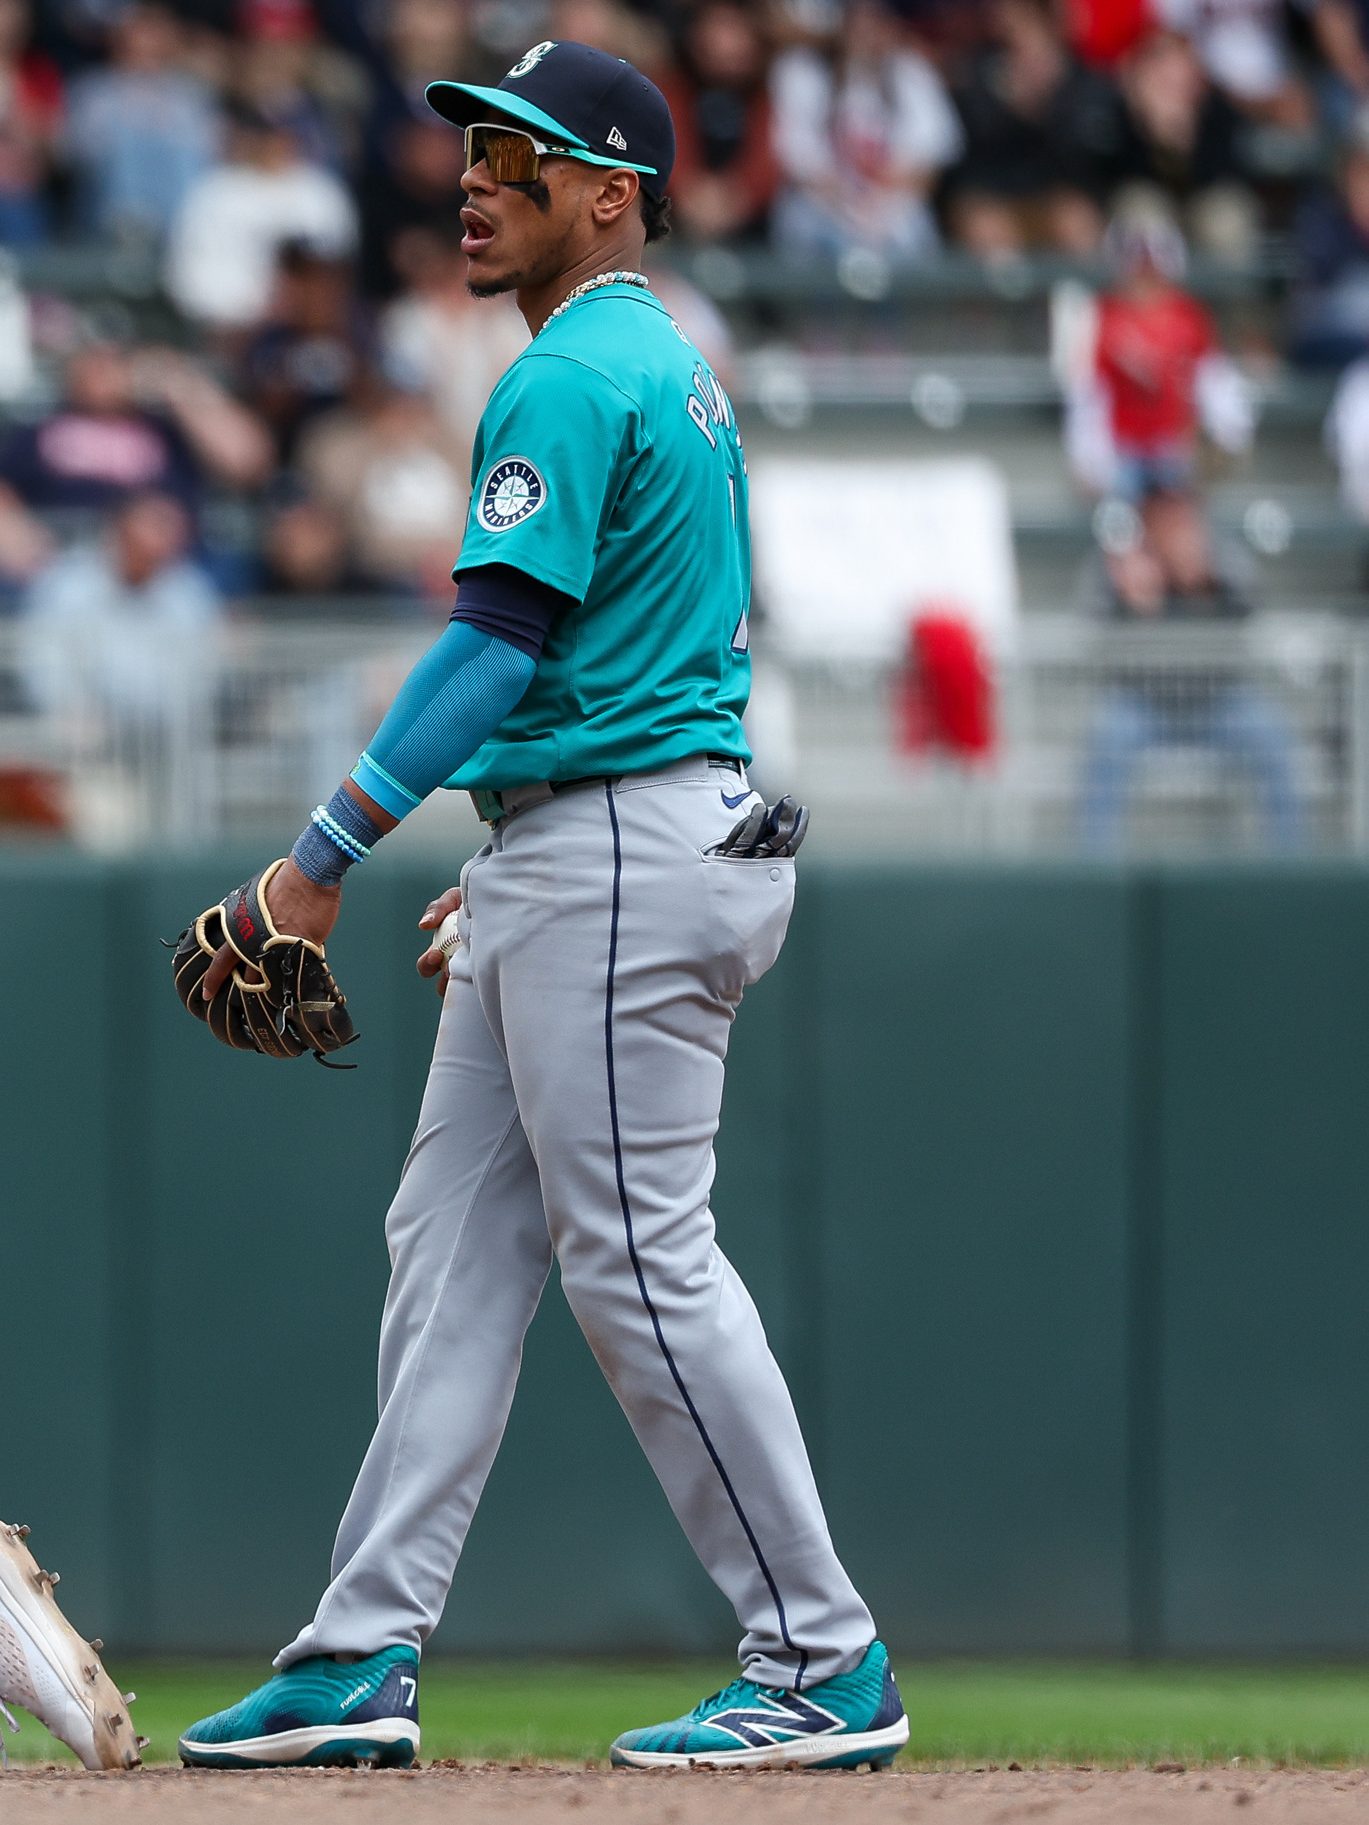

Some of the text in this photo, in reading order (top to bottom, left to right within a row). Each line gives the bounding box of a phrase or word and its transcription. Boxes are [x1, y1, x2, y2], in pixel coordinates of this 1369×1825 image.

[490, 464, 538, 490] SEATTLE
[485, 503, 533, 526] MARINERS
[400, 1675, 417, 1708] 7
